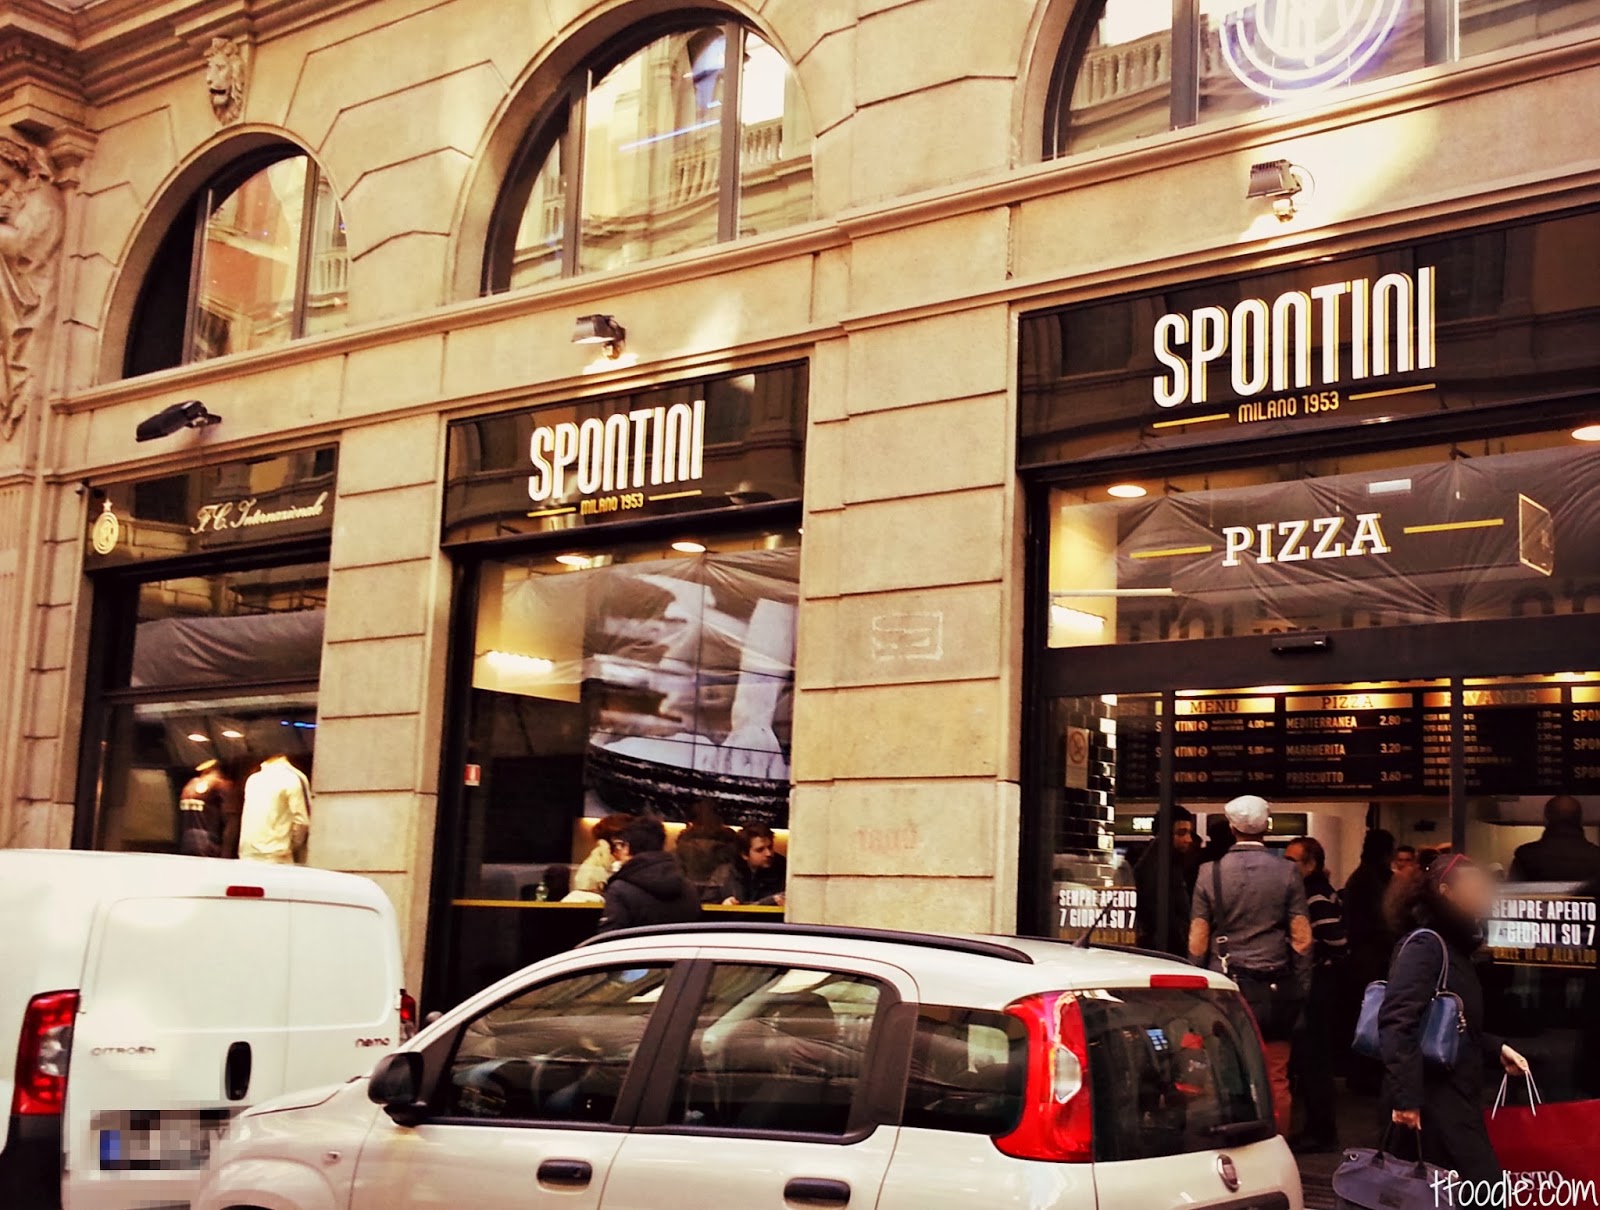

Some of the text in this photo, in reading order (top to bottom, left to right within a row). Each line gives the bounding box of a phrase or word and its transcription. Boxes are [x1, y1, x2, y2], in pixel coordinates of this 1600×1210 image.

[1152, 266, 1436, 408] SPONTINI
[1238, 391, 1339, 423] MILANO 1953
[528, 400, 705, 501] SPONTINI
[580, 493, 644, 515] MILANO 1953
[1222, 512, 1392, 567] PIZZA
[1190, 700, 1239, 713] MENU
[1321, 696, 1374, 709] PIZZA
[1285, 715, 1358, 728] MEDITERRANEA
[1285, 743, 1346, 756] MARGHERITA
[1059, 889, 1137, 908] SEMPRE APERTO
[1059, 908, 1066, 927] 7
[1109, 909, 1126, 929] SU
[1128, 909, 1136, 929] 7
[1491, 899, 1597, 921] SEMPRE APERTO
[1507, 921, 1556, 944] GIORNI
[1561, 923, 1581, 946] SU
[1586, 924, 1596, 946] 7
